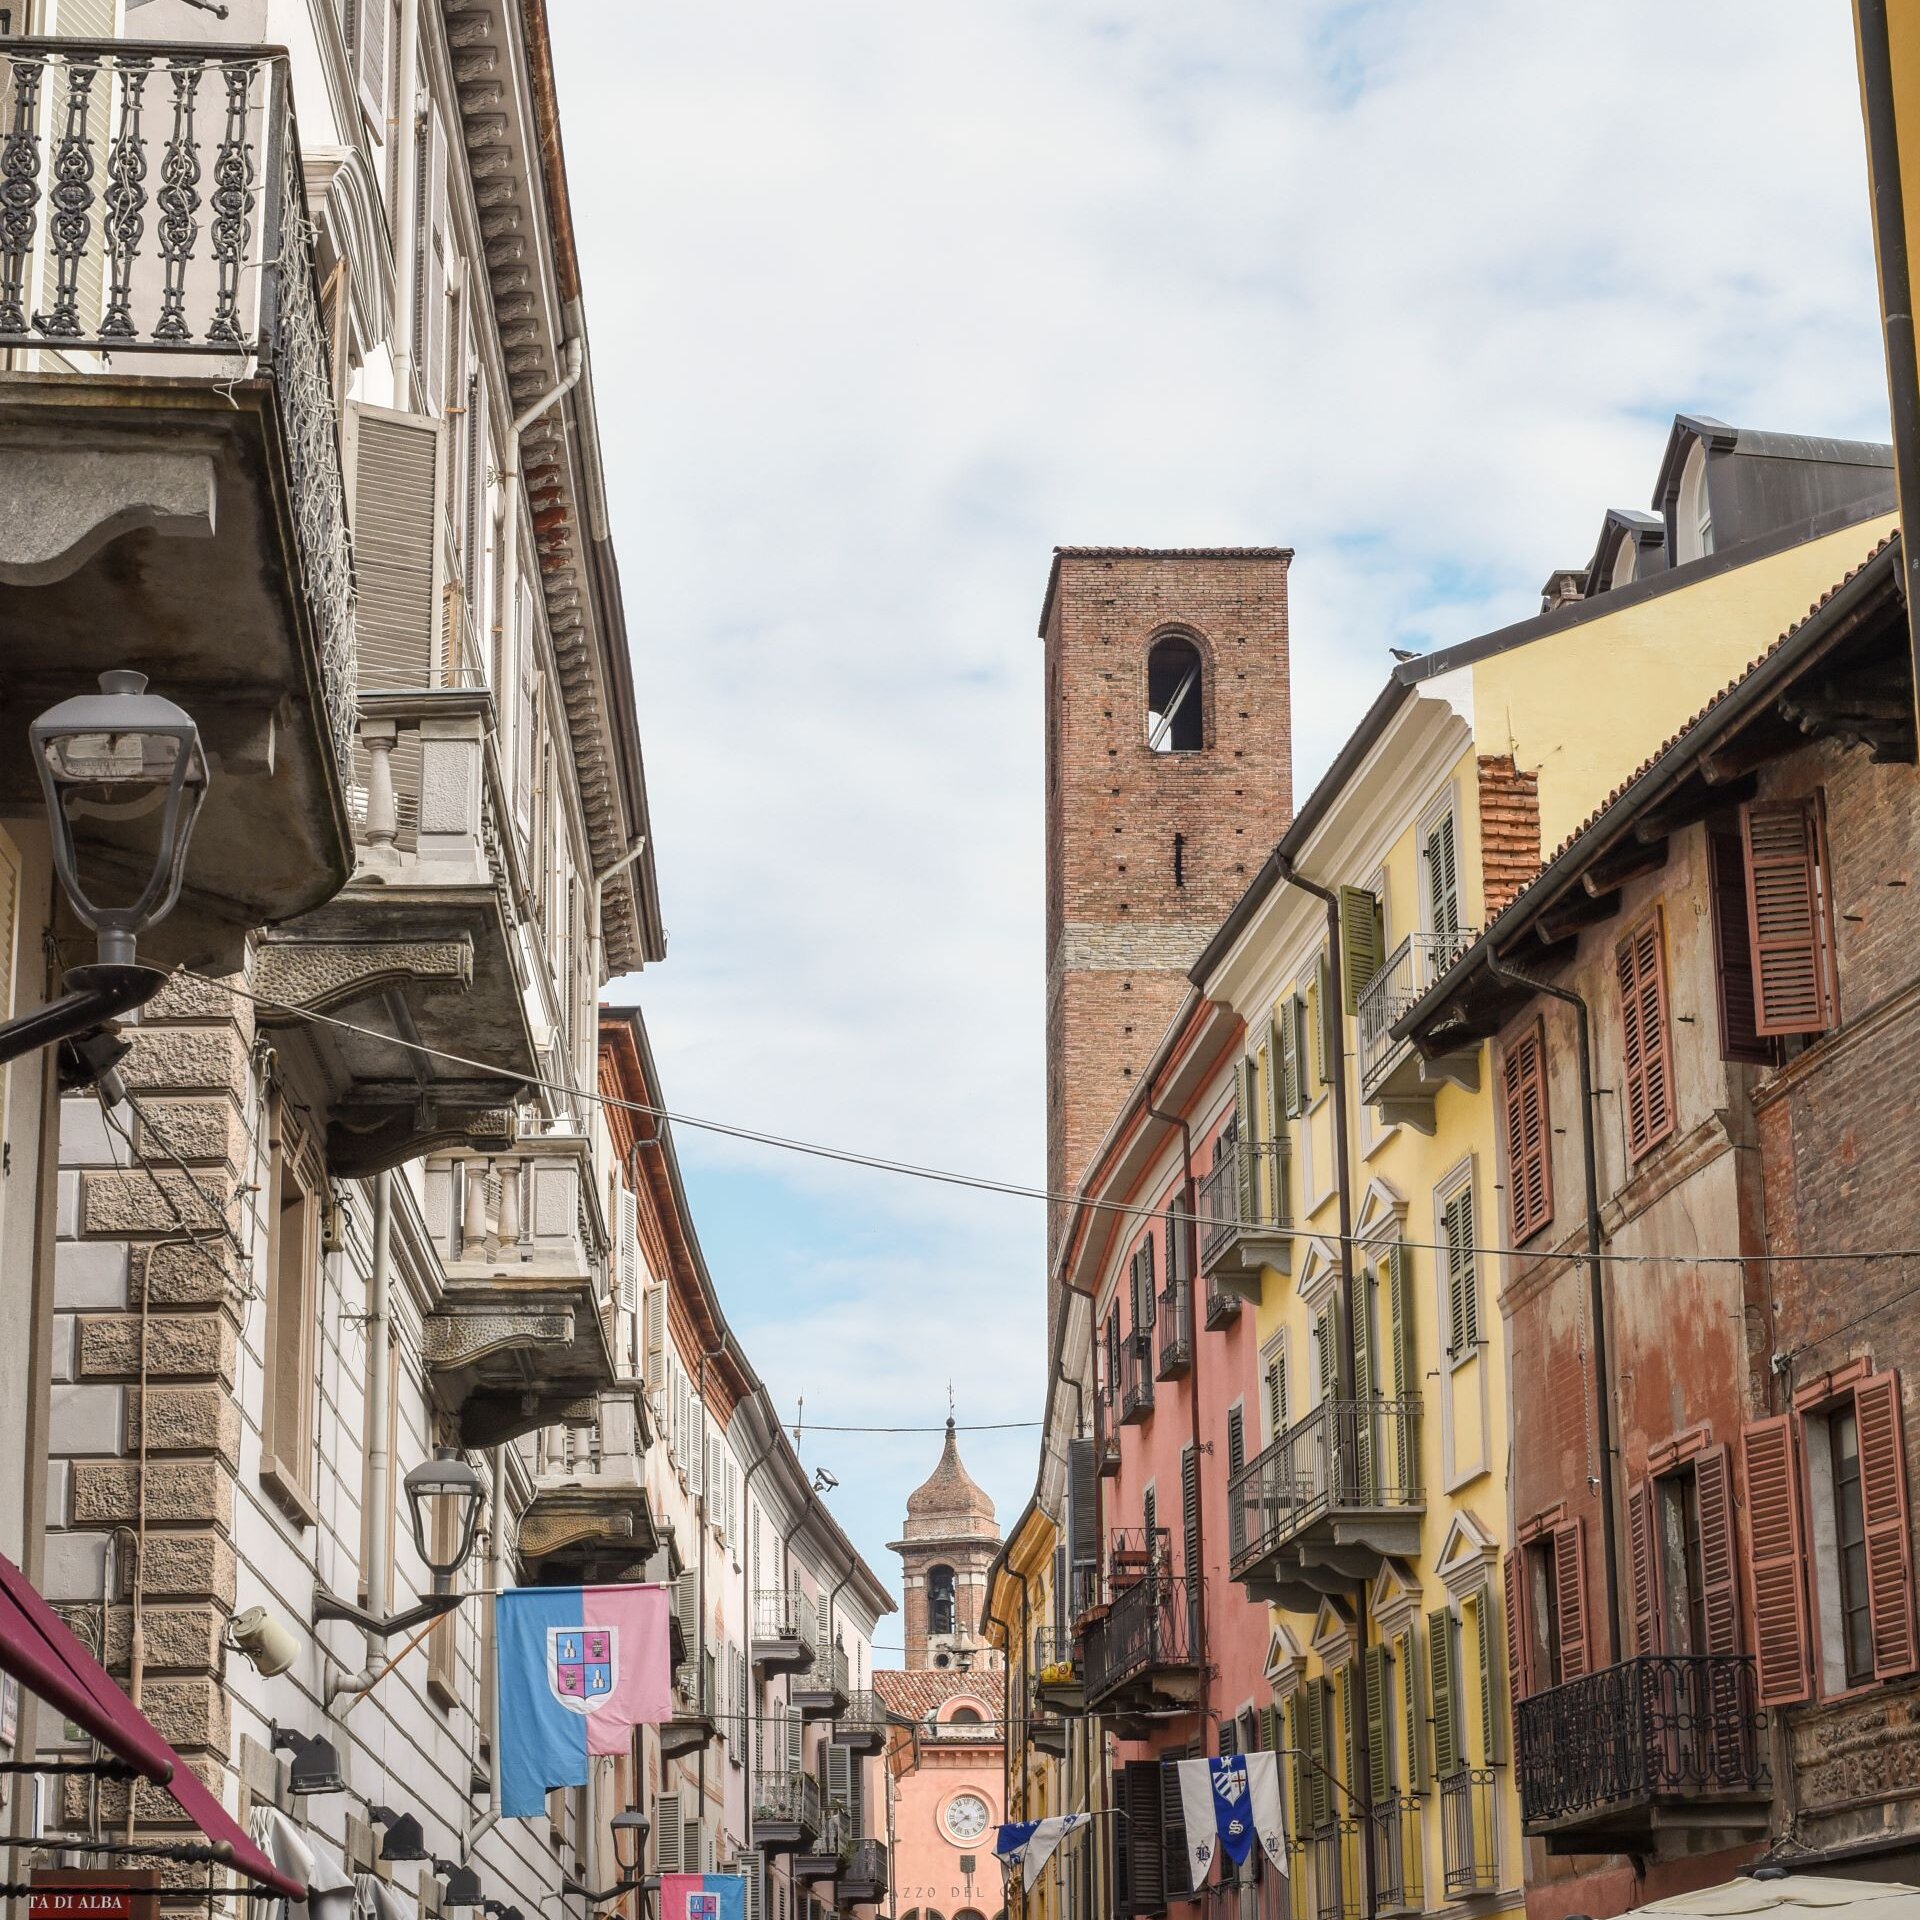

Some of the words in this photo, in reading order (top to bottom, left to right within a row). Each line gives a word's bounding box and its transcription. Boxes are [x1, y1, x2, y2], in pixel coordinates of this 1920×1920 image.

[951, 1887, 985, 1898] DEL
[54, 1895, 73, 1909] DI
[78, 1895, 123, 1909] ALBA
